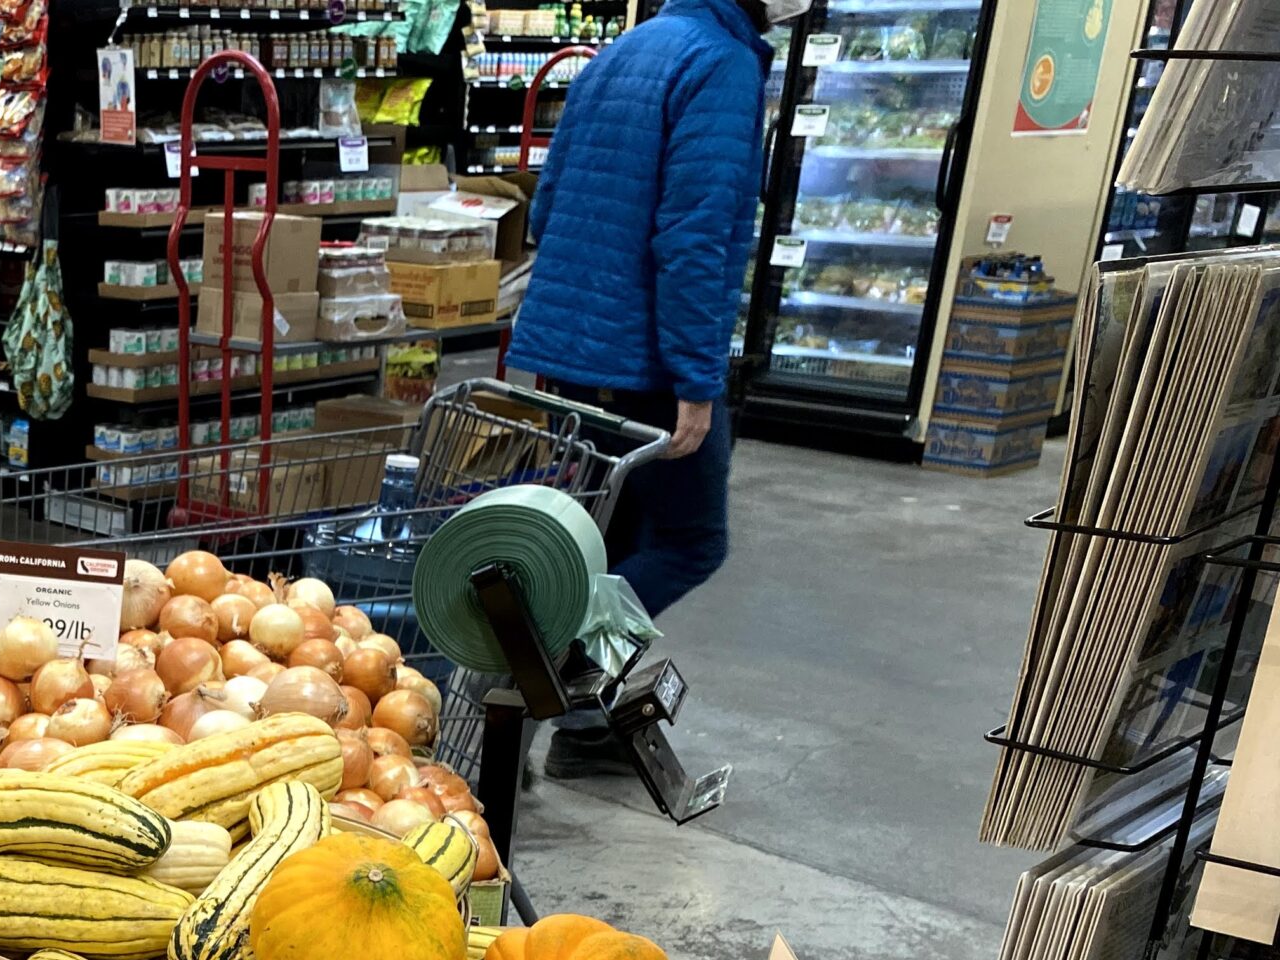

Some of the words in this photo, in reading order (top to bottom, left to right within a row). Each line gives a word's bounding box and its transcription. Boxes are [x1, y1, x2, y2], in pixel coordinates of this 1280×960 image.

[20, 555, 66, 568] CALIFORNIA
[36, 587, 72, 596] ORGANIC
[26, 597, 50, 607] Yellow
[53, 600, 80, 610] Onions
